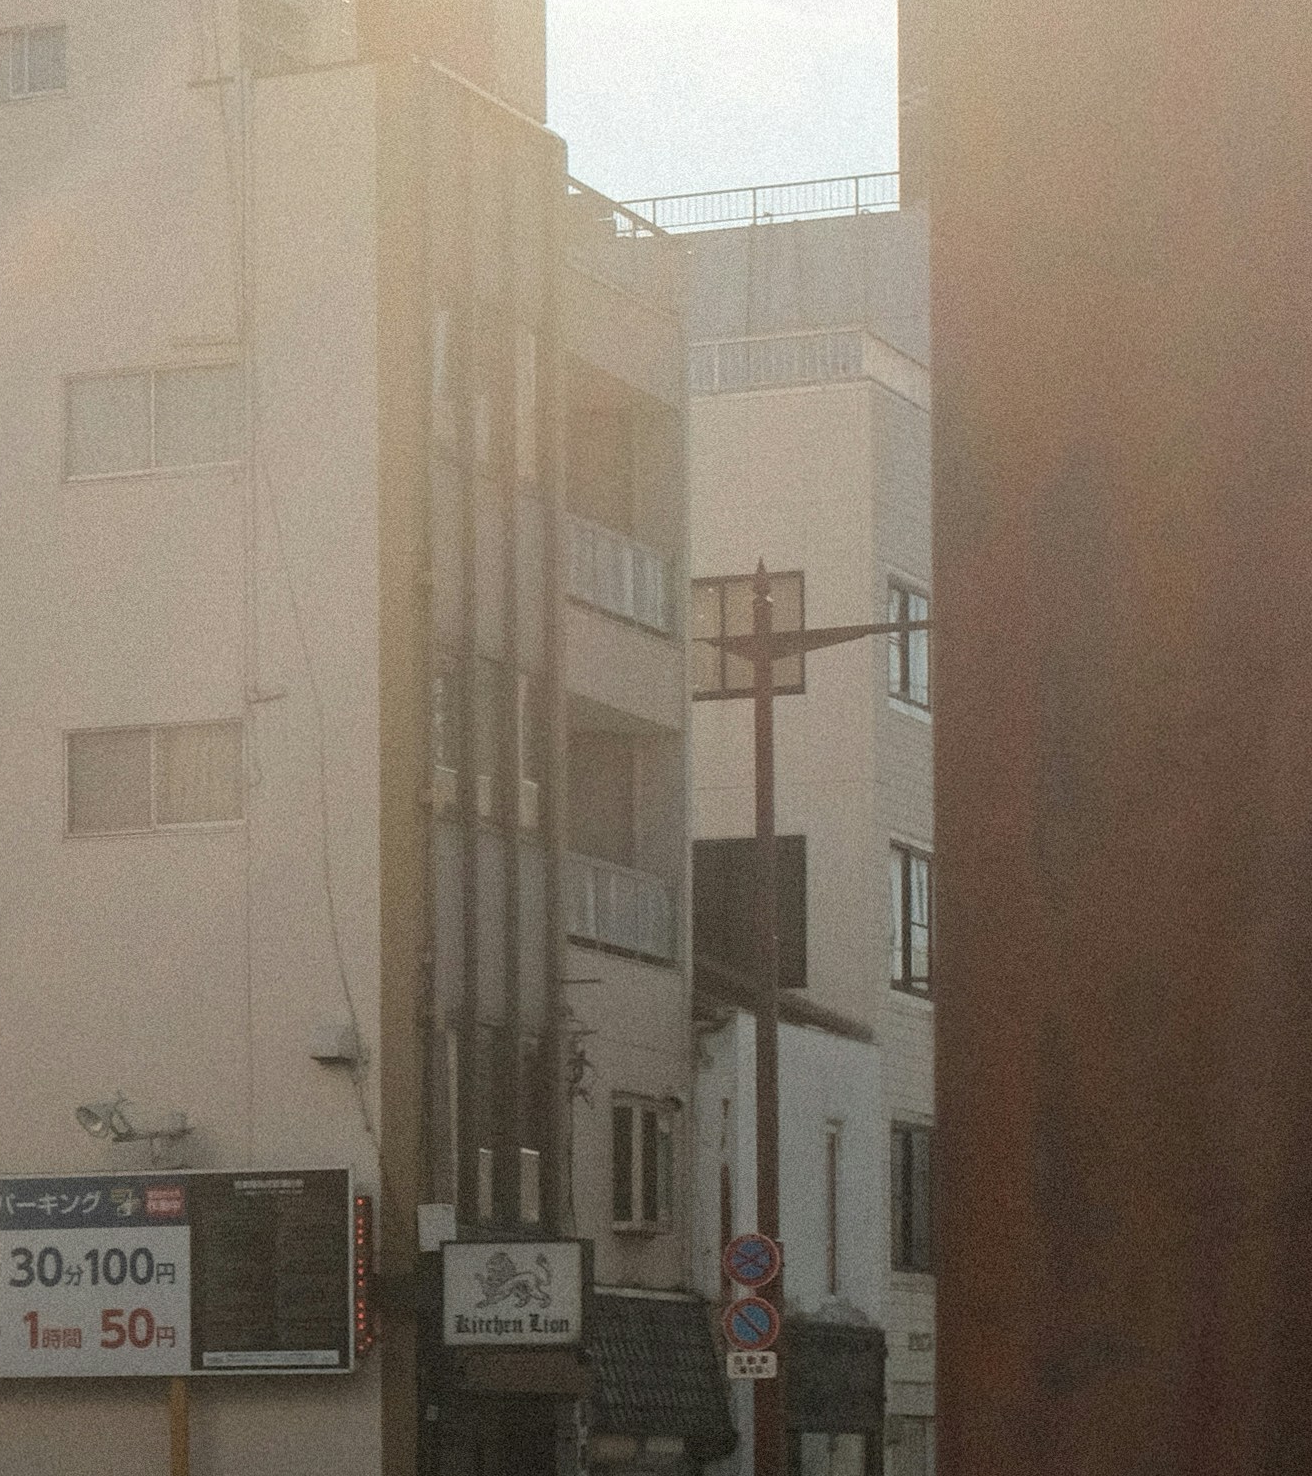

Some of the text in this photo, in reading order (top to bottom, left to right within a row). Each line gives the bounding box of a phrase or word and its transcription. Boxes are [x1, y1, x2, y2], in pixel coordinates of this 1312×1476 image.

[99, 1308, 176, 1351] 50円
[454, 1313, 570, 1336] Kitchen Lion
